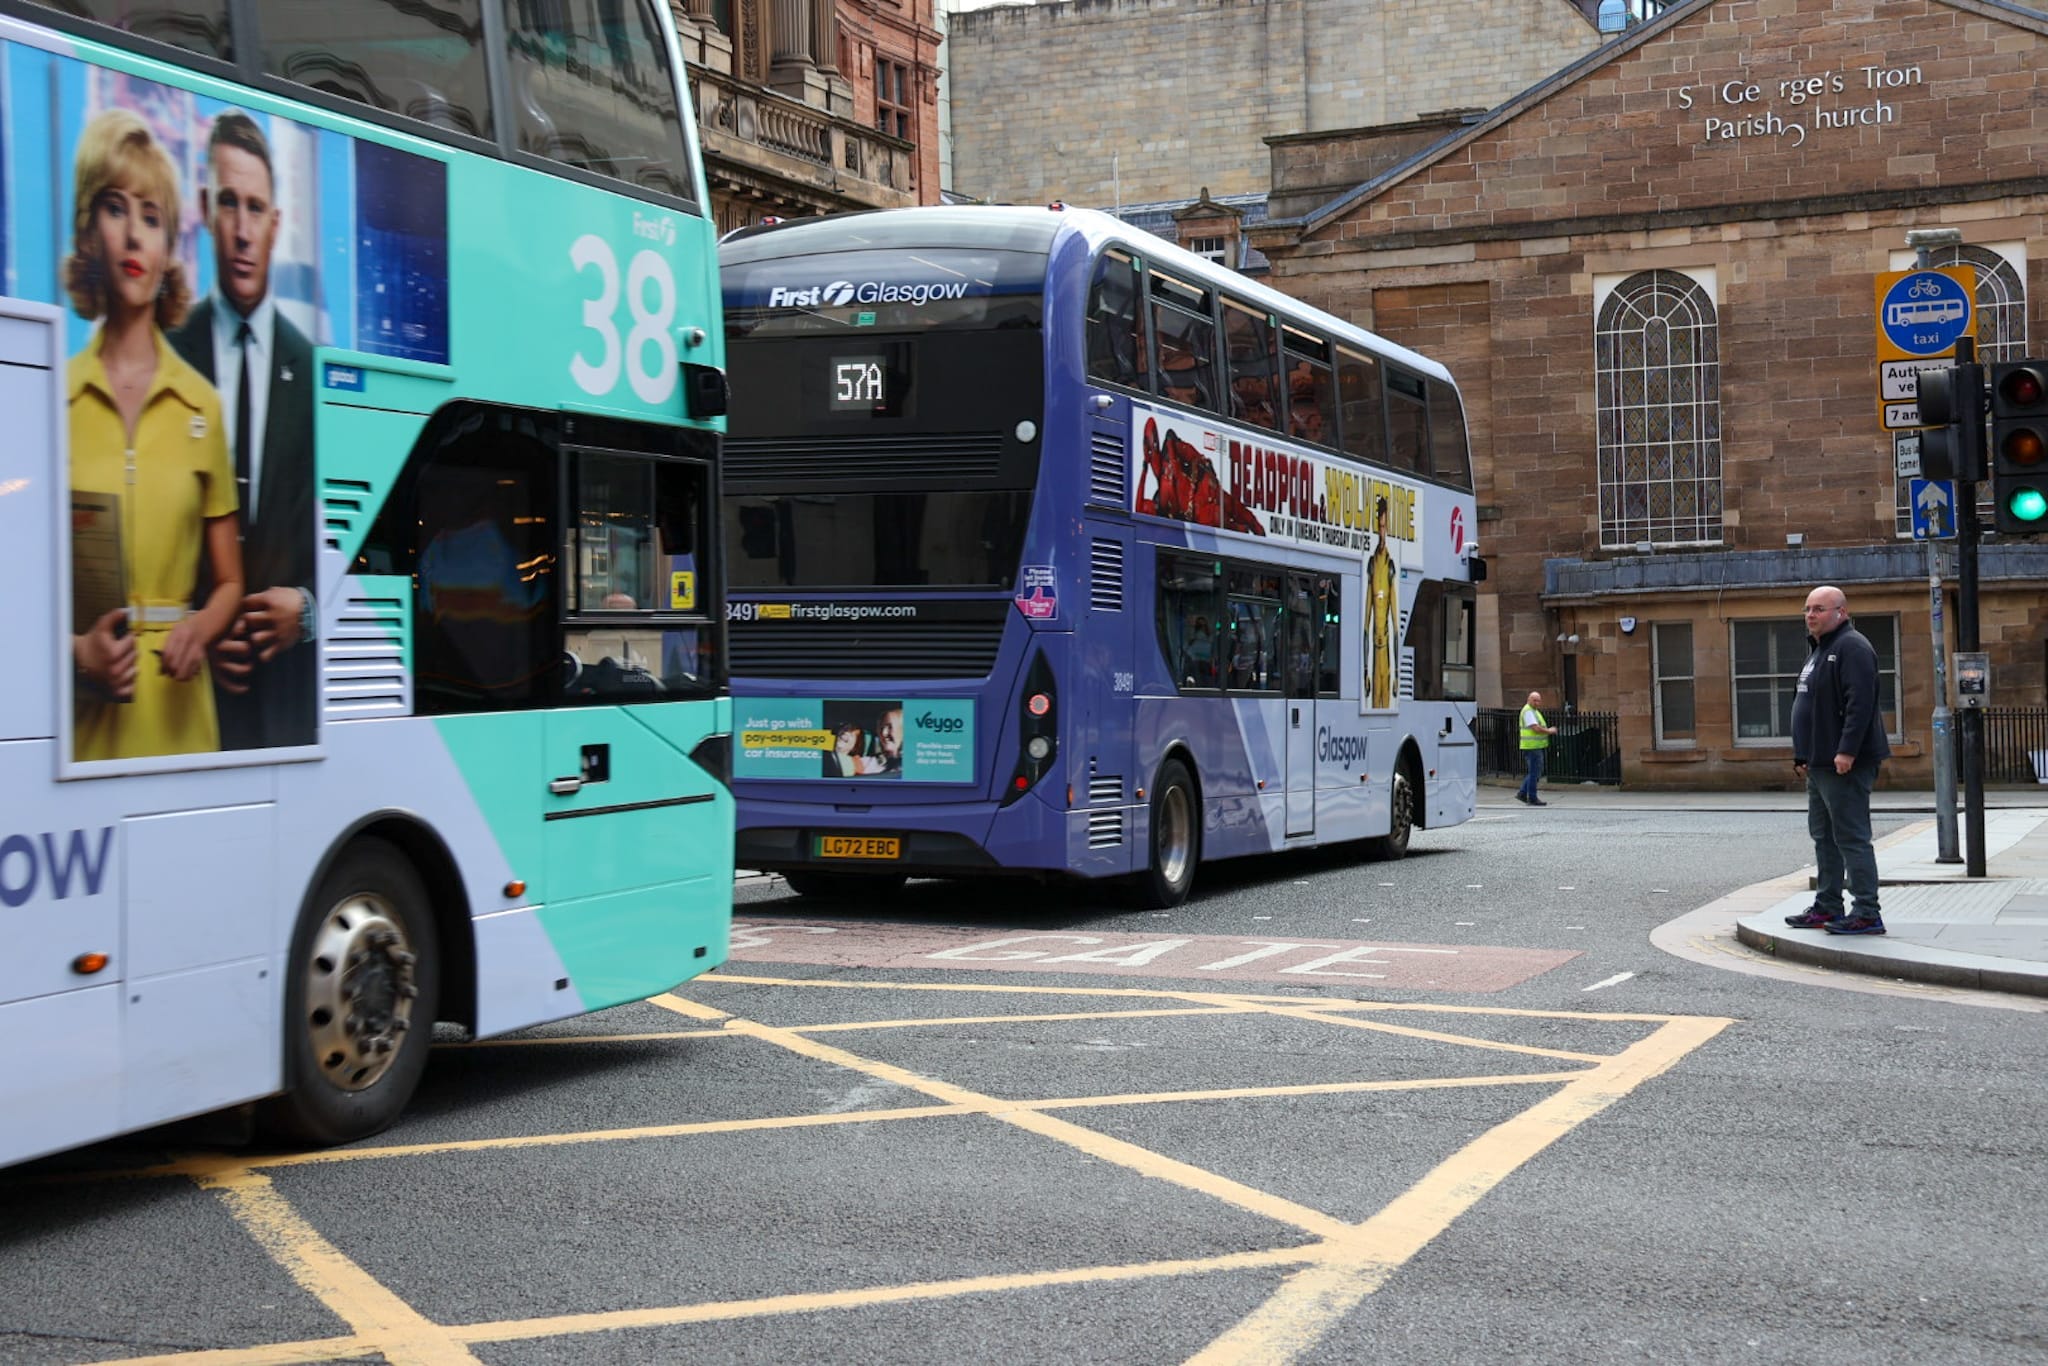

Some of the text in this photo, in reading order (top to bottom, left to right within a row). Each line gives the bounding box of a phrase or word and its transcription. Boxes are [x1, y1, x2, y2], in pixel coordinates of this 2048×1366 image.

[1860, 65, 1922, 90] Tron
[768, 281, 969, 308] First Glasgow
[568, 233, 678, 406] 38
[1913, 331, 1940, 345] taxi
[836, 362, 883, 401] 57A
[1890, 409, 1900, 421] 7
[1899, 444, 1912, 456] Bus
[1228, 439, 1319, 522] DEADPOOL
[1269, 514, 1286, 537] ONLY
[1286, 518, 1294, 537] IN
[1295, 520, 1321, 543] CINEMAS
[1321, 526, 1350, 549] THURSDAY
[1350, 531, 1363, 551] JULY
[790, 603, 917, 621] firstglasgow.com
[745, 717, 812, 731] Just go with
[744, 733, 826, 746] pay-as-you-go
[1317, 726, 1369, 771] Glasgow
[744, 750, 763, 759] car
[823, 838, 896, 856] LG72 EBC
[919, 934, 1460, 979] GATE
